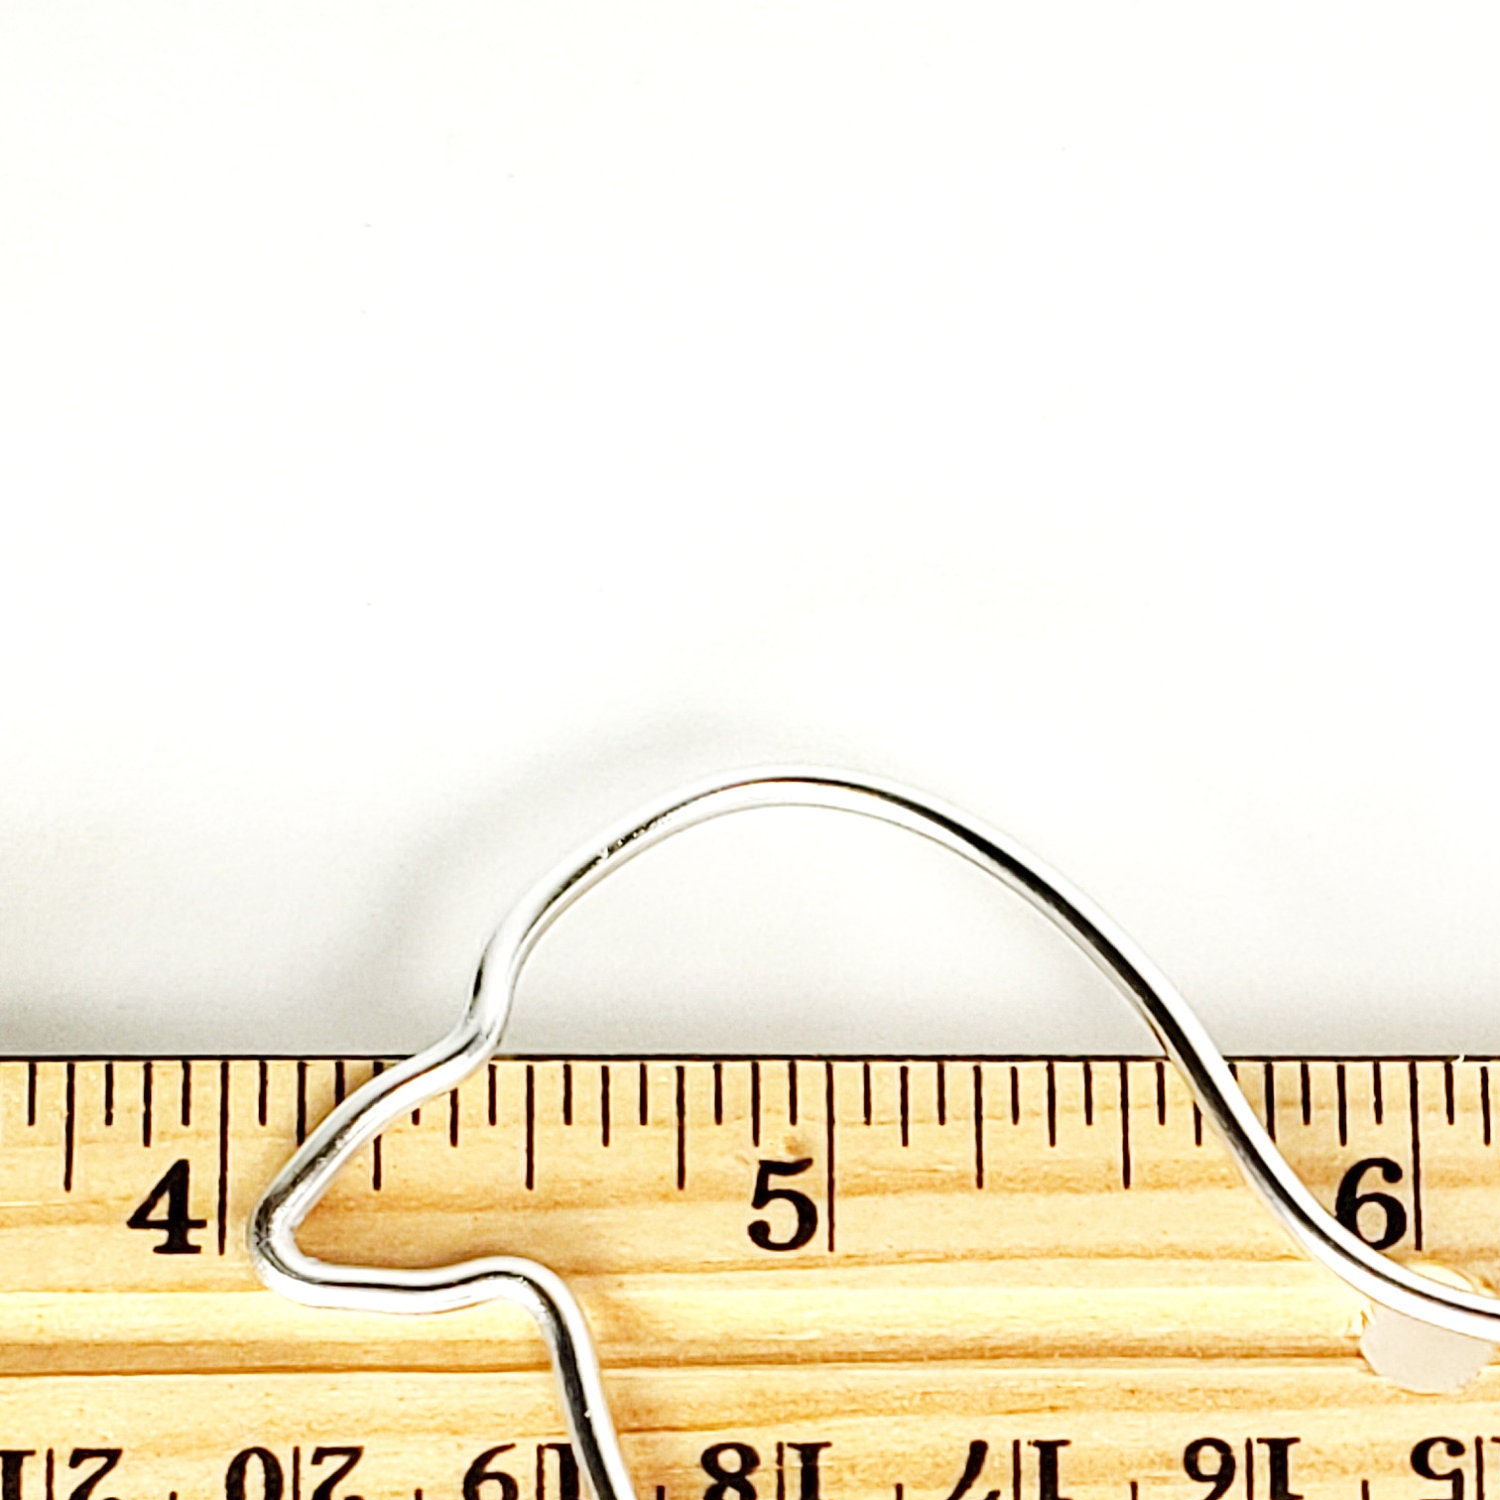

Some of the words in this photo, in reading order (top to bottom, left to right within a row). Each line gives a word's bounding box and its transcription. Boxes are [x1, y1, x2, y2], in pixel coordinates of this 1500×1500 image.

[126, 1158, 208, 1255] 4
[747, 1157, 818, 1252] 5
[1334, 1157, 1407, 1252] 6
